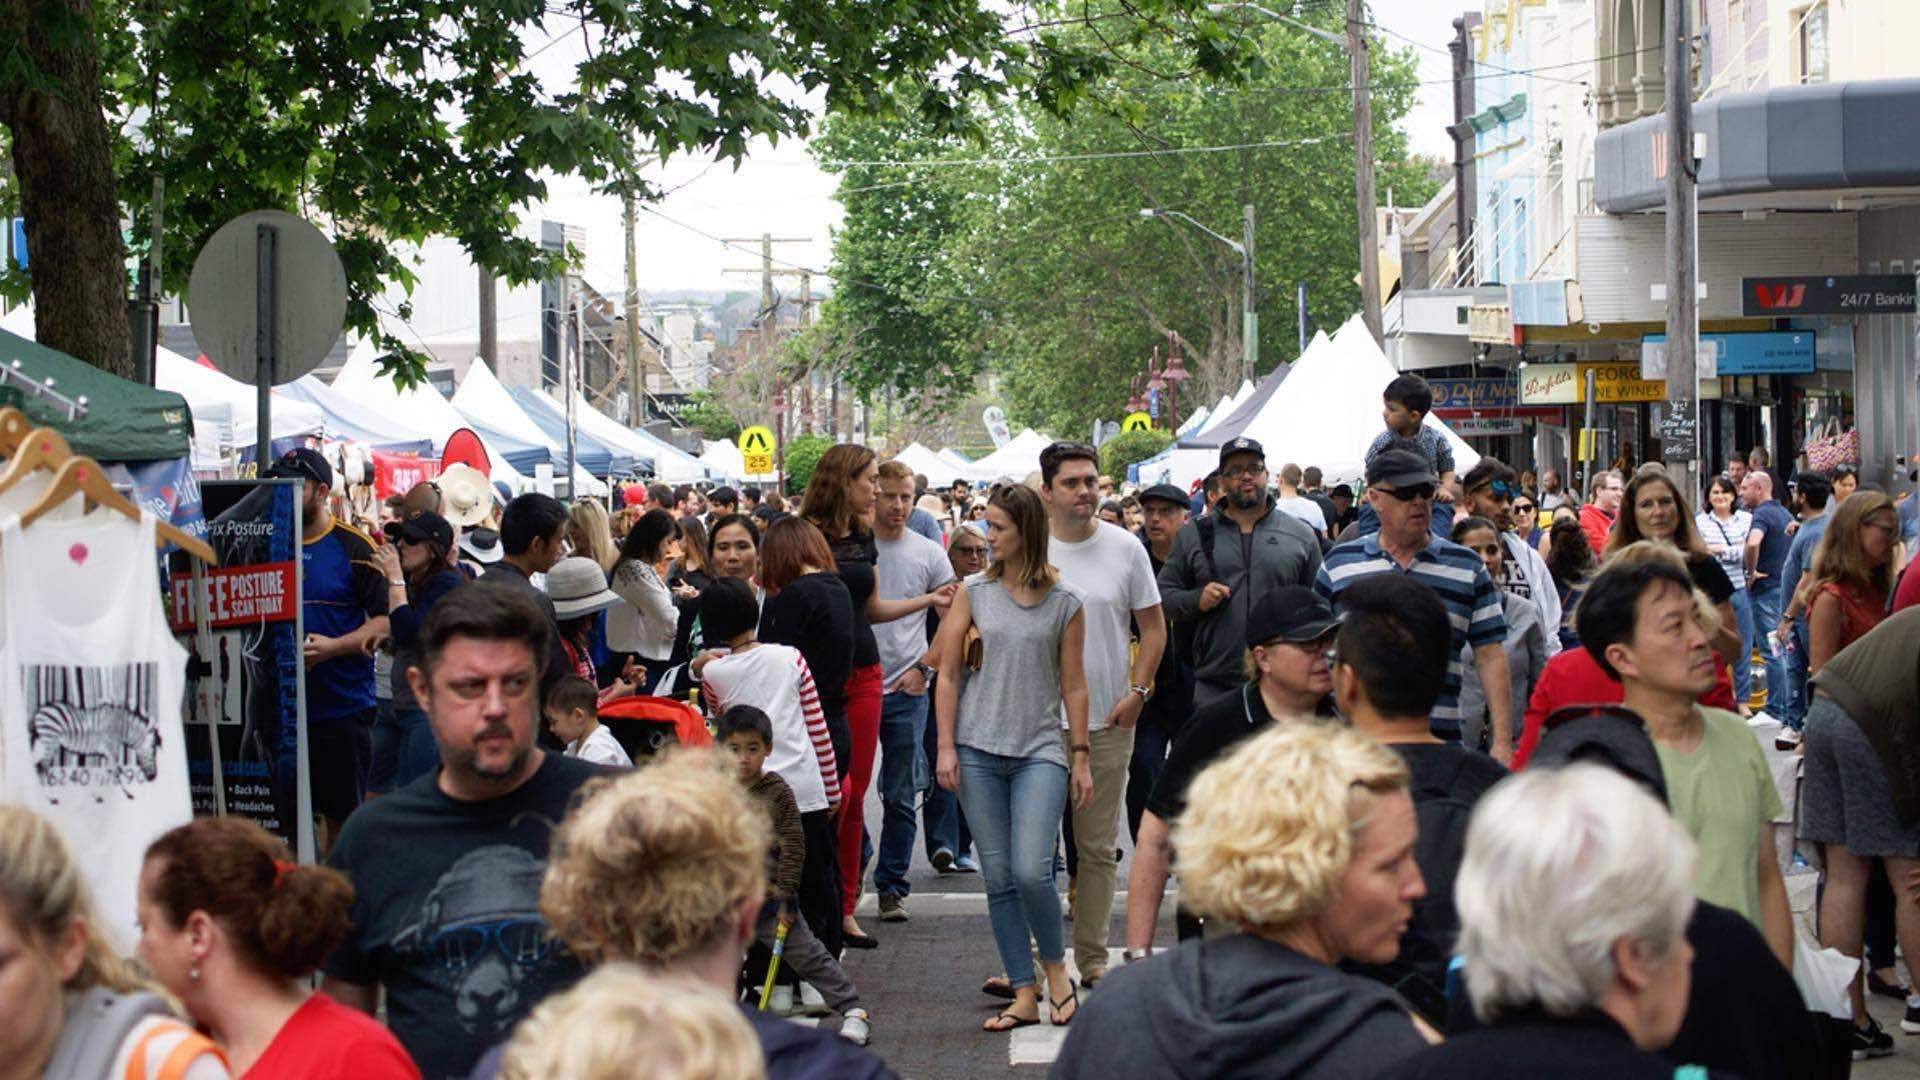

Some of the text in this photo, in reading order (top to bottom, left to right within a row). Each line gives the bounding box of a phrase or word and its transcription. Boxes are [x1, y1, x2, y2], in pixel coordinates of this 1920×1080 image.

[1840, 292, 1916, 307] 24/7 Bankin
[1584, 367, 1640, 380] EORG
[1616, 383, 1662, 398] WINES
[750, 456, 767, 467] 25
[226, 516, 275, 537] Posture
[230, 569, 285, 599] POSTURE
[230, 594, 284, 618] SCAN TODAY
[234, 784, 271, 796] Back Pain
[234, 800, 276, 812] Headaches
